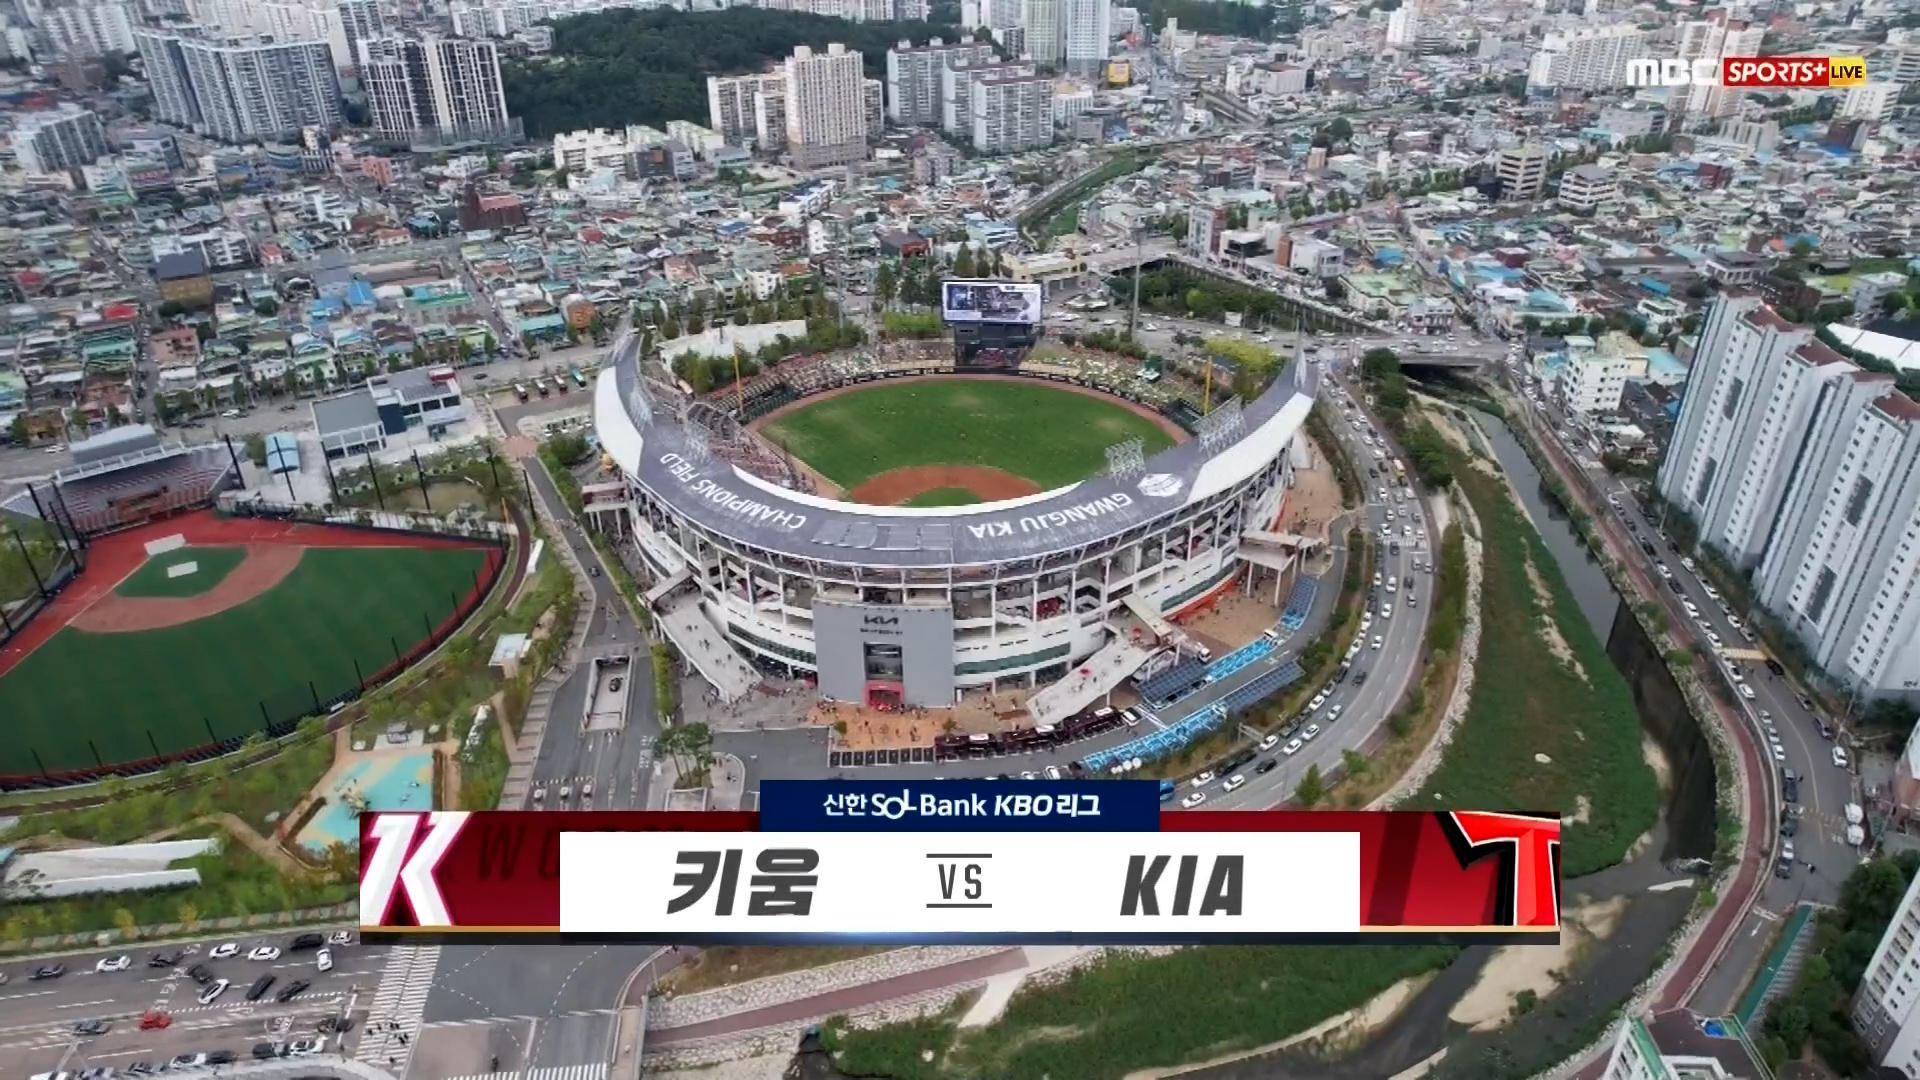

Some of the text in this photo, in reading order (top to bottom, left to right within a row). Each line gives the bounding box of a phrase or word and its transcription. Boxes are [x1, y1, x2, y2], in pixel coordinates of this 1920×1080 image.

[659, 452, 807, 530] CHAMPIONS FIELD
[966, 492, 1134, 539] GWANGJU KIA
